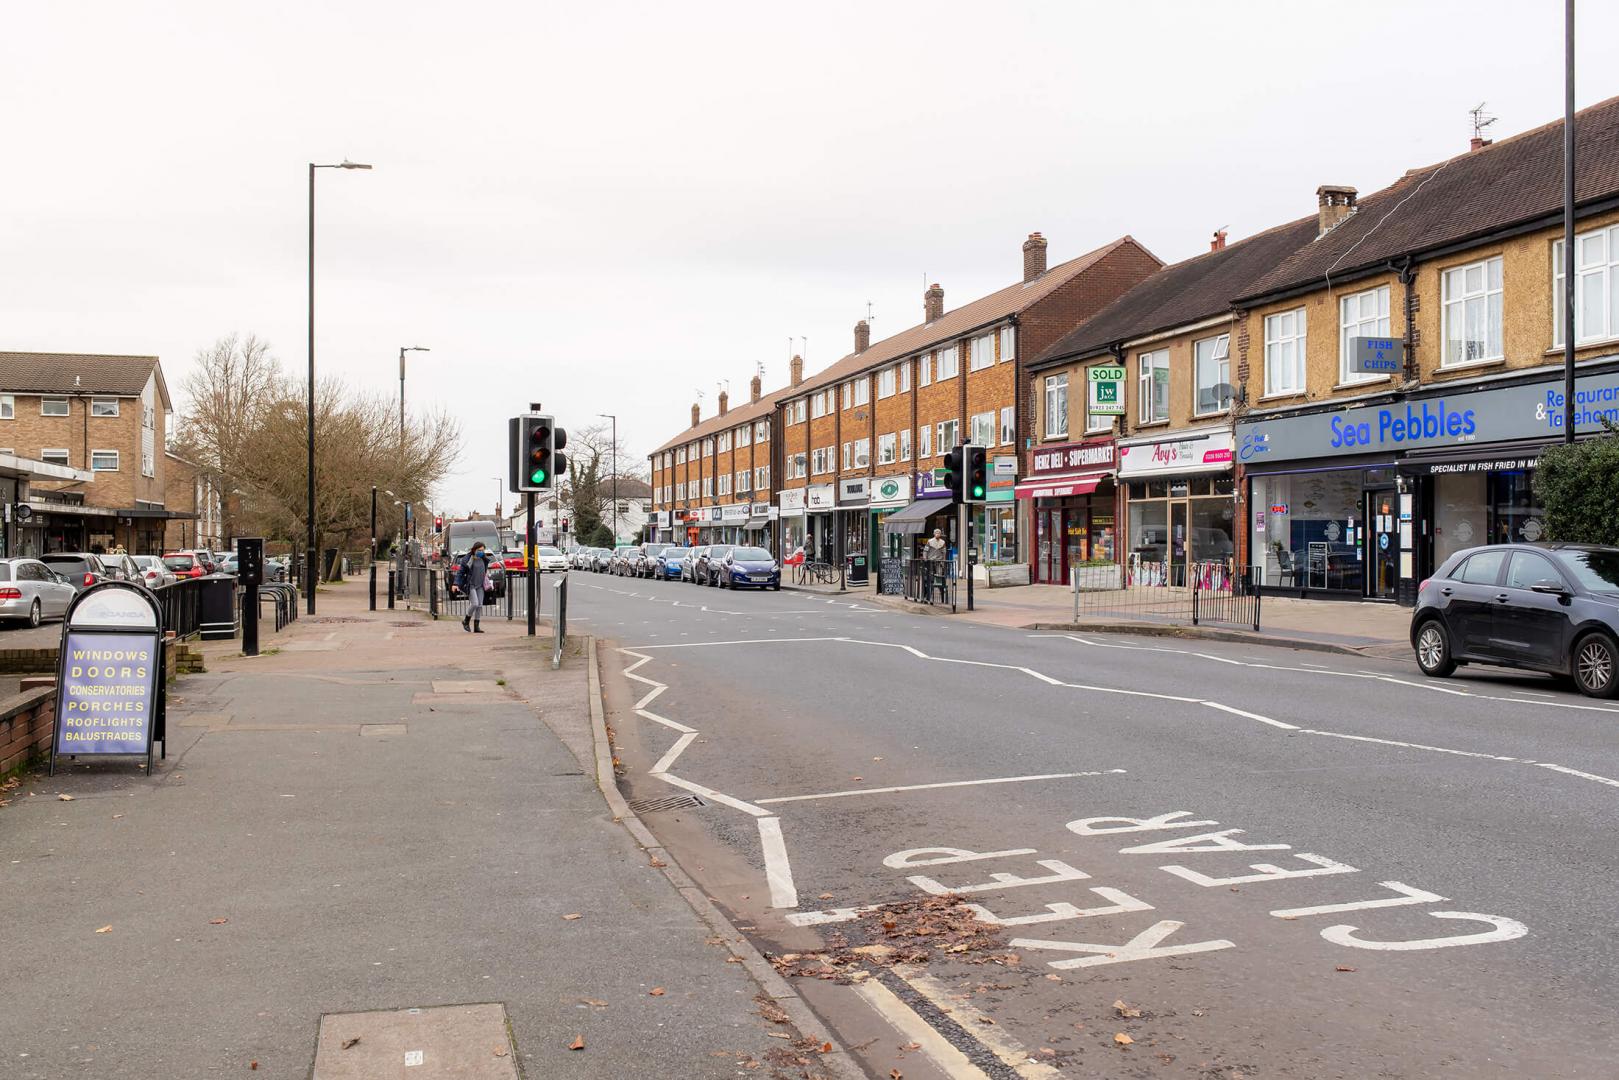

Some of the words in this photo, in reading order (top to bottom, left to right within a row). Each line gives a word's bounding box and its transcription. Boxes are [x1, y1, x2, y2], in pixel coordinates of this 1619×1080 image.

[1367, 340, 1393, 350] FISH
[1376, 351, 1384, 360] &
[1363, 360, 1397, 370] CHIPS
[1092, 369, 1123, 380] SOLD
[1535, 402, 1546, 421] &
[1330, 414, 1371, 449] Sea
[1378, 399, 1476, 443] Pebbles
[1034, 454, 1050, 471] DENIZ
[1050, 452, 1063, 469] DELI
[1069, 445, 1115, 467] SUPERMARKET
[1430, 464, 1468, 474] SPECIALIST
[1468, 463, 1477, 472] IN
[1477, 462, 1494, 472] FISH
[1494, 461, 1517, 471] FRIED
[1517, 460, 1527, 469] IN
[73, 650, 148, 661] WINDOWS
[71, 666, 147, 678] DOORS
[69, 685, 145, 696] CONSERVATORIES
[68, 701, 144, 712] PORCHES
[66, 718, 143, 727] ROOFLIGHTS
[65, 732, 142, 742] BALUSTRADES
[1065, 810, 1529, 951] CLEAR
[882, 846, 1236, 971] KEEP
